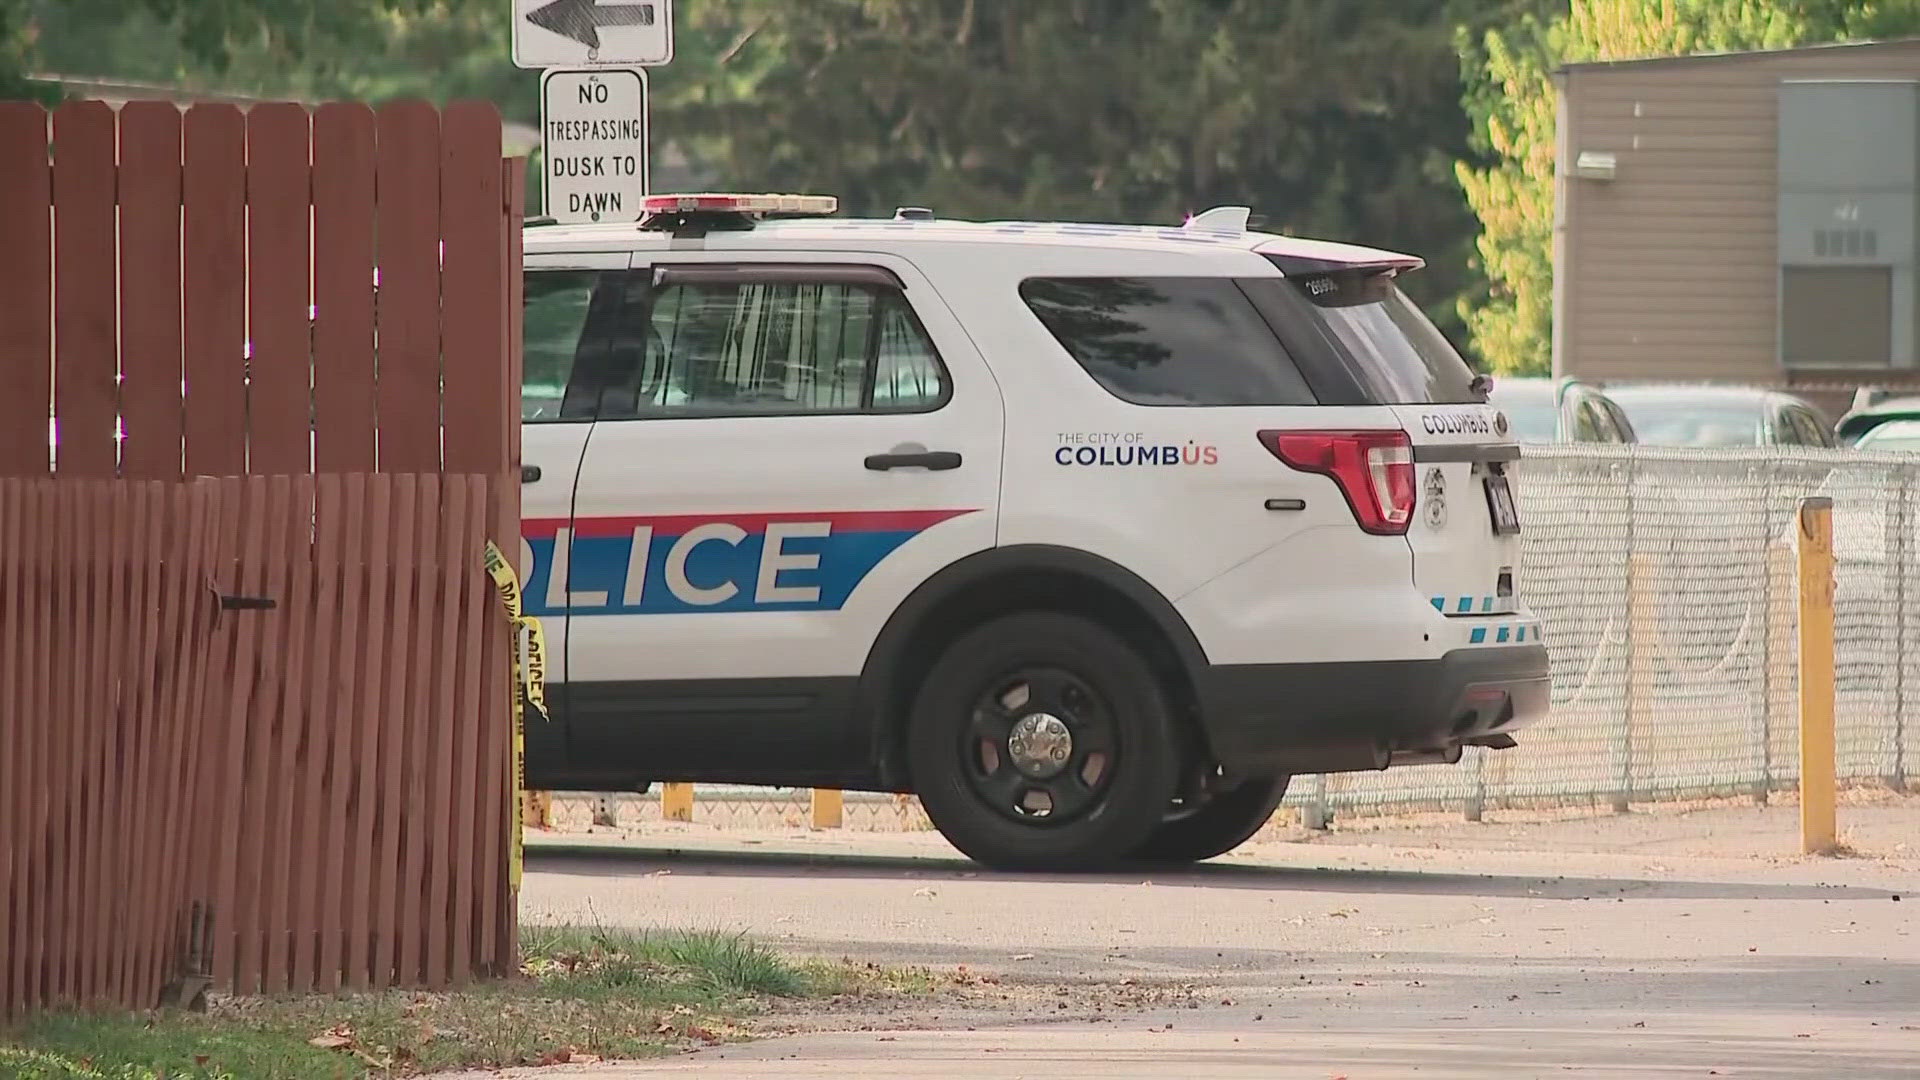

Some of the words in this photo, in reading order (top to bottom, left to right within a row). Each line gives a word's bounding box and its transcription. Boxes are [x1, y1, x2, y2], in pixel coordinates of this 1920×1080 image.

[578, 83, 609, 104] NO
[550, 119, 640, 141] TRESPASSING
[553, 156, 605, 177] DUSK
[612, 155, 636, 177] TO
[569, 192, 622, 213] DAWN
[1421, 414, 1489, 435] COLUMBUS
[1057, 432, 1083, 444] THE
[1088, 432, 1120, 444] CITY
[1124, 431, 1144, 444] OF
[1055, 441, 1219, 466] COLUMBUS
[521, 521, 832, 608] LICE
